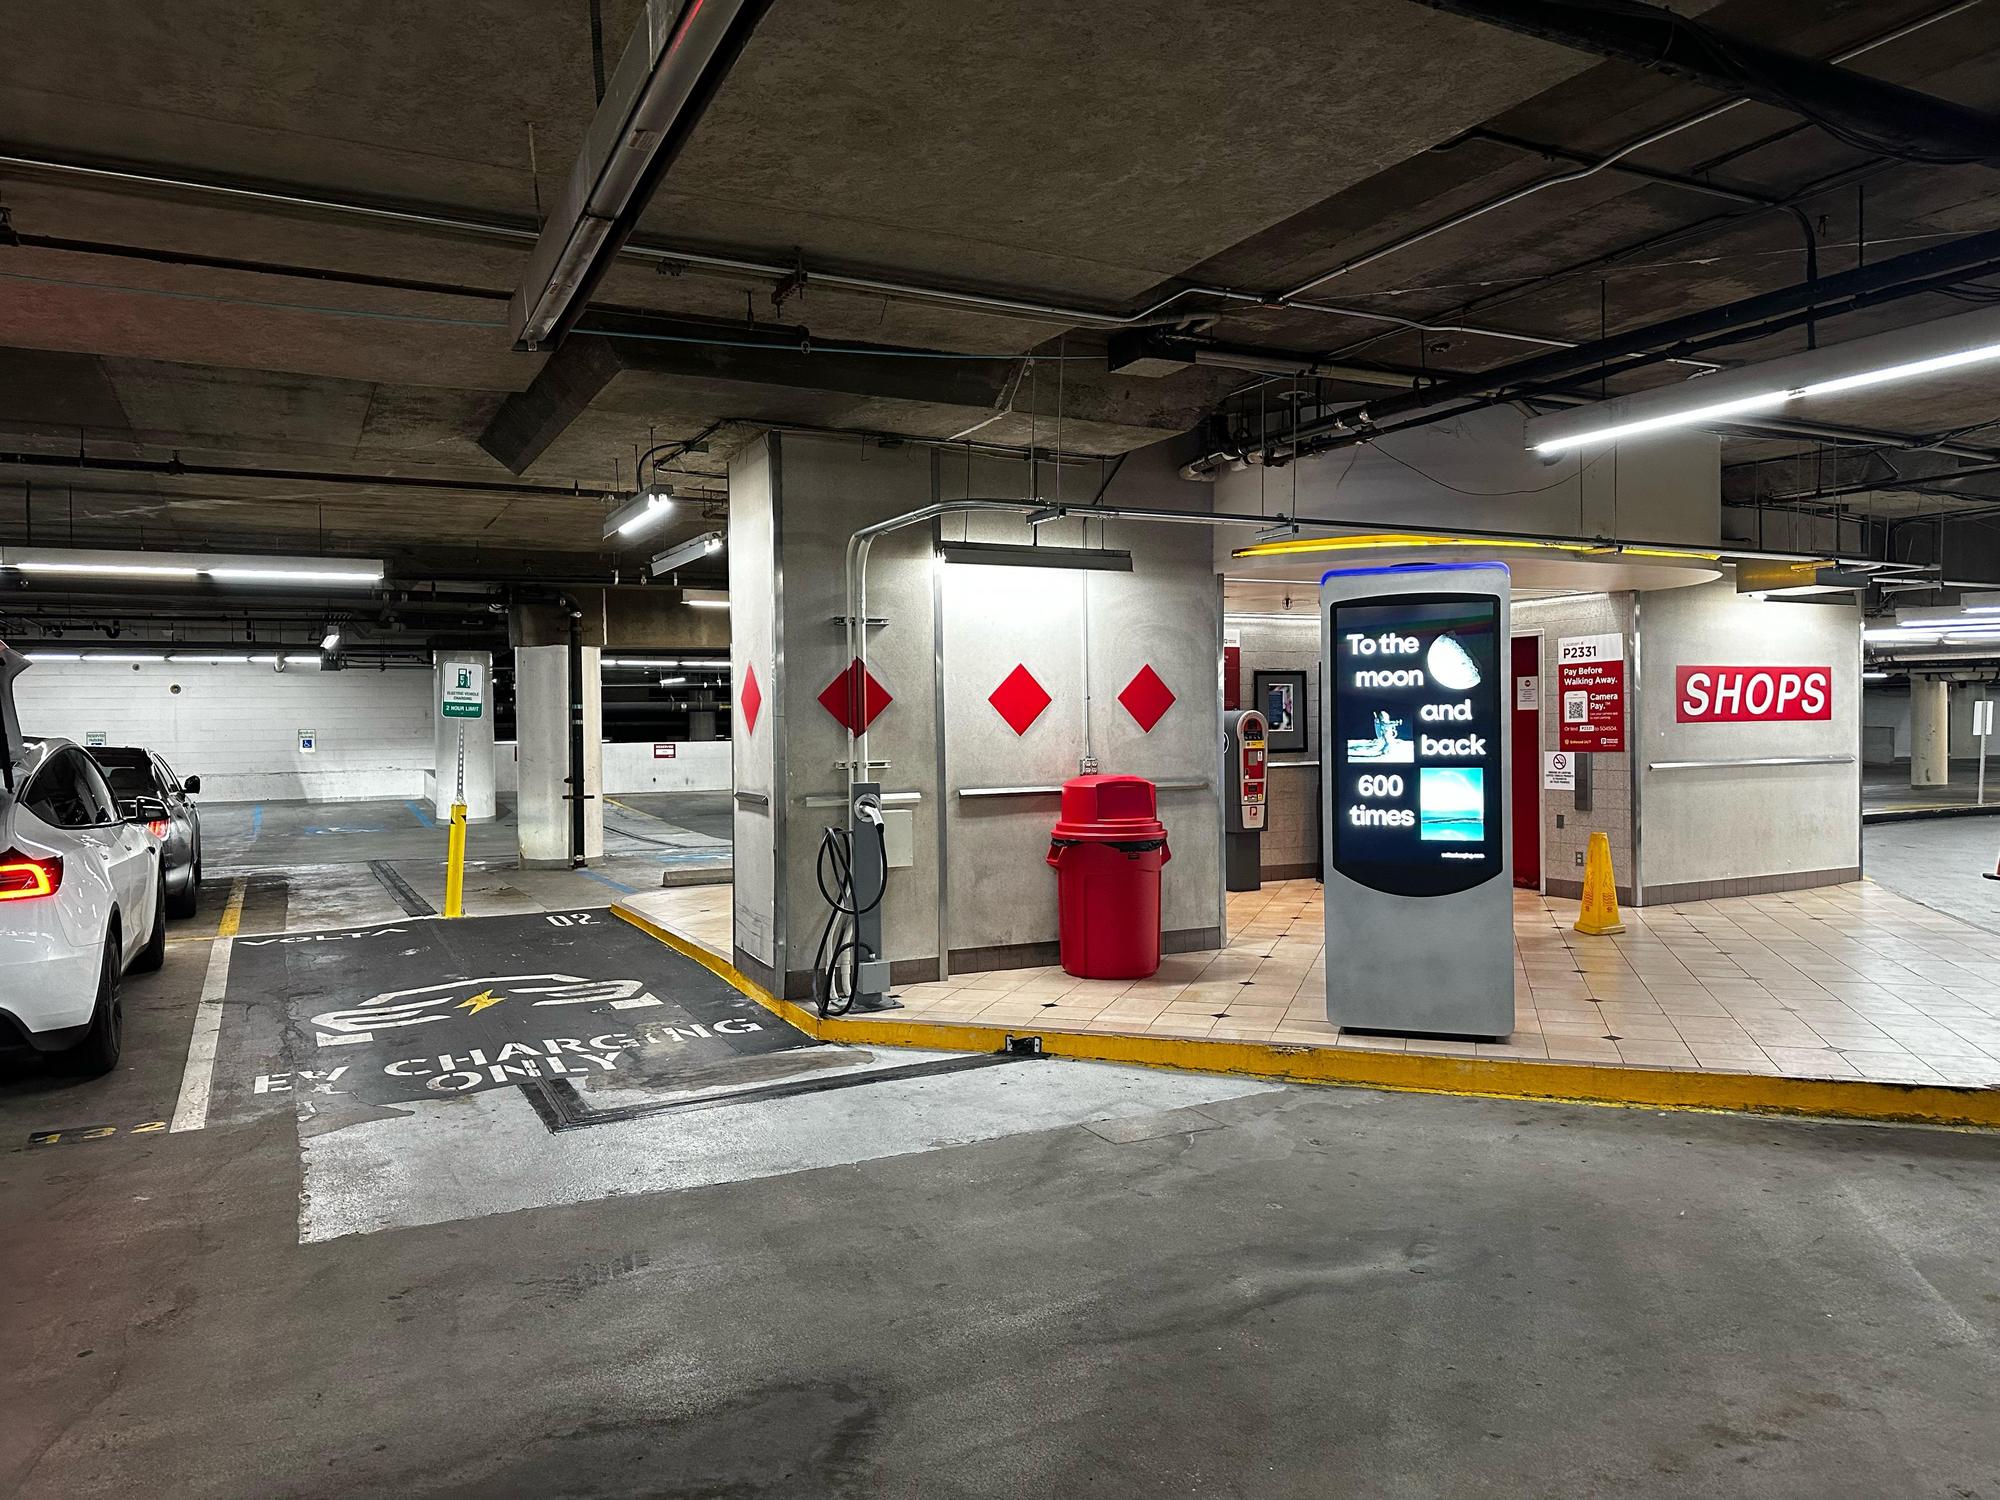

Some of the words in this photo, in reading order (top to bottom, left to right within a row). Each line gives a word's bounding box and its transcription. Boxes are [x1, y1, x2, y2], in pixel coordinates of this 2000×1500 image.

[1346, 633, 1376, 655] To
[1379, 632, 1420, 654] the
[1563, 646, 1597, 659] P2331
[1355, 669, 1424, 687] moon
[1564, 668, 1577, 676] Pay
[1579, 667, 1603, 675] Before
[1564, 677, 1593, 685] Walking
[1595, 676, 1618, 685] Away.
[1590, 693, 1618, 701] Camera
[1683, 672, 1827, 716] SHOPS
[1420, 699, 1473, 721] and
[1421, 733, 1486, 756] back
[1358, 774, 1404, 797] 600
[1349, 804, 1415, 827] times
[546, 912, 600, 927] 02
[239, 928, 408, 946] VOLTA
[253, 1066, 350, 1094] EV
[426, 1051, 621, 1091] ONLY
